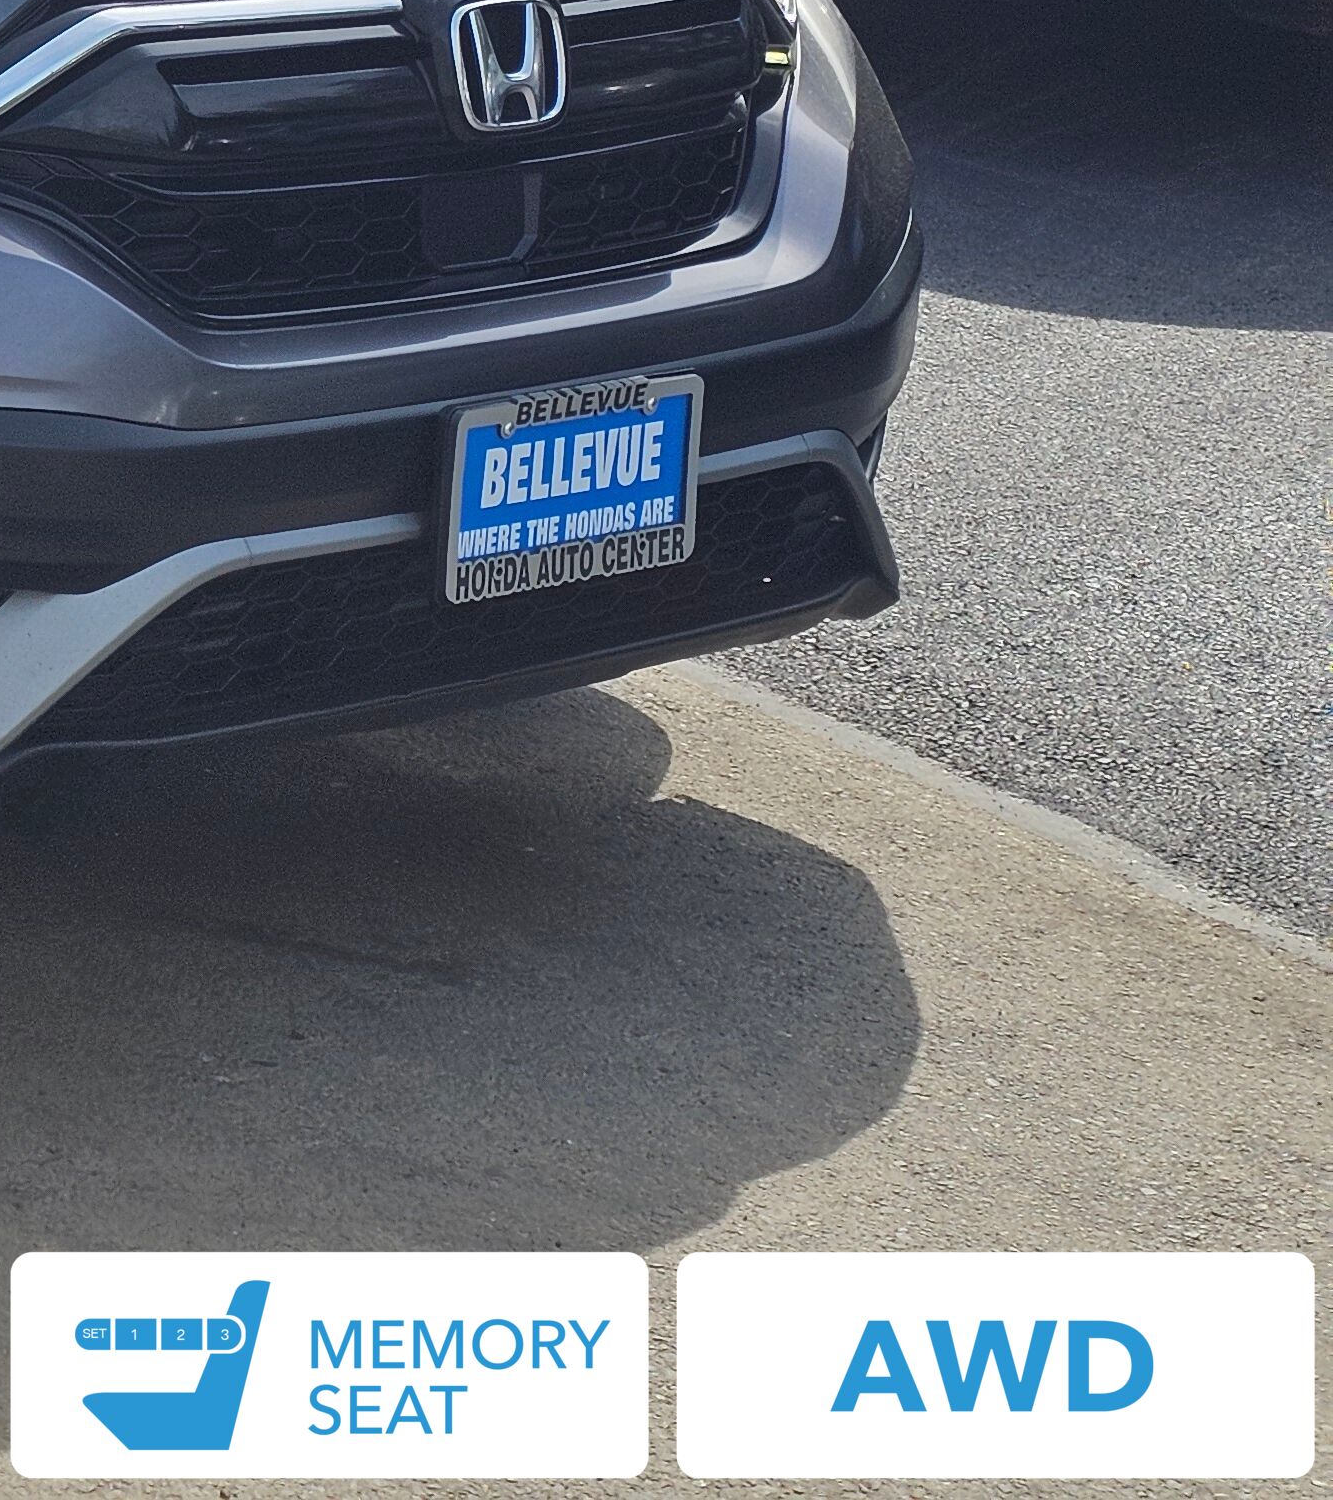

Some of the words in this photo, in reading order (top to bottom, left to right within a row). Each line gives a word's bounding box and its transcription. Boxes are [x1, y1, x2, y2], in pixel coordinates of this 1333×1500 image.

[517, 383, 648, 425] BELLEVUE
[480, 421, 664, 509] BELLEVUE
[457, 522, 522, 560] WHERE
[527, 515, 559, 549] THE
[565, 504, 635, 542] HONDAS
[640, 495, 675, 526] ARE
[455, 558, 531, 601] HONDA
[537, 541, 594, 587] AUTO
[602, 530, 687, 576] CENTER
